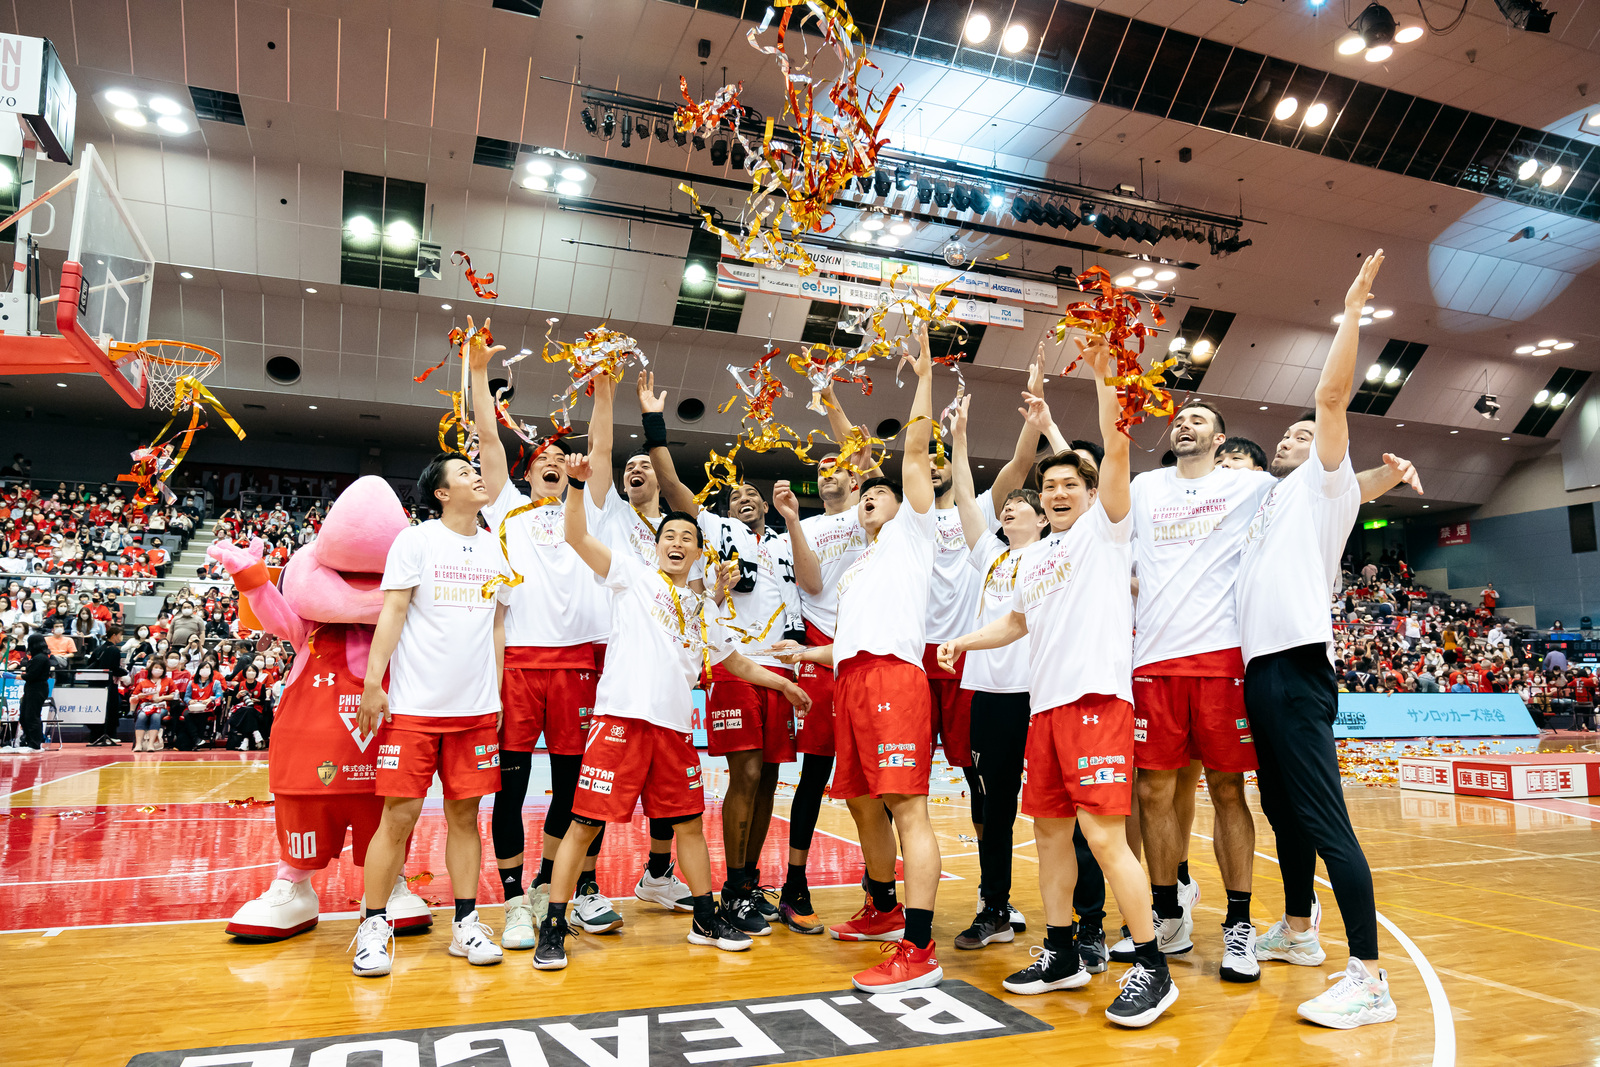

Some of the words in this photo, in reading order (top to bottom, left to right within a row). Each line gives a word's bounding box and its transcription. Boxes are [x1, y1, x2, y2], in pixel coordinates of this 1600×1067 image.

[1153, 516, 1222, 542] CHAMPION
[1441, 524, 1468, 538] 禁煙
[339, 695, 361, 705] CHIB
[1407, 709, 1505, 722] サンロッカーズ渋谷
[1459, 770, 1508, 791] 廃車王
